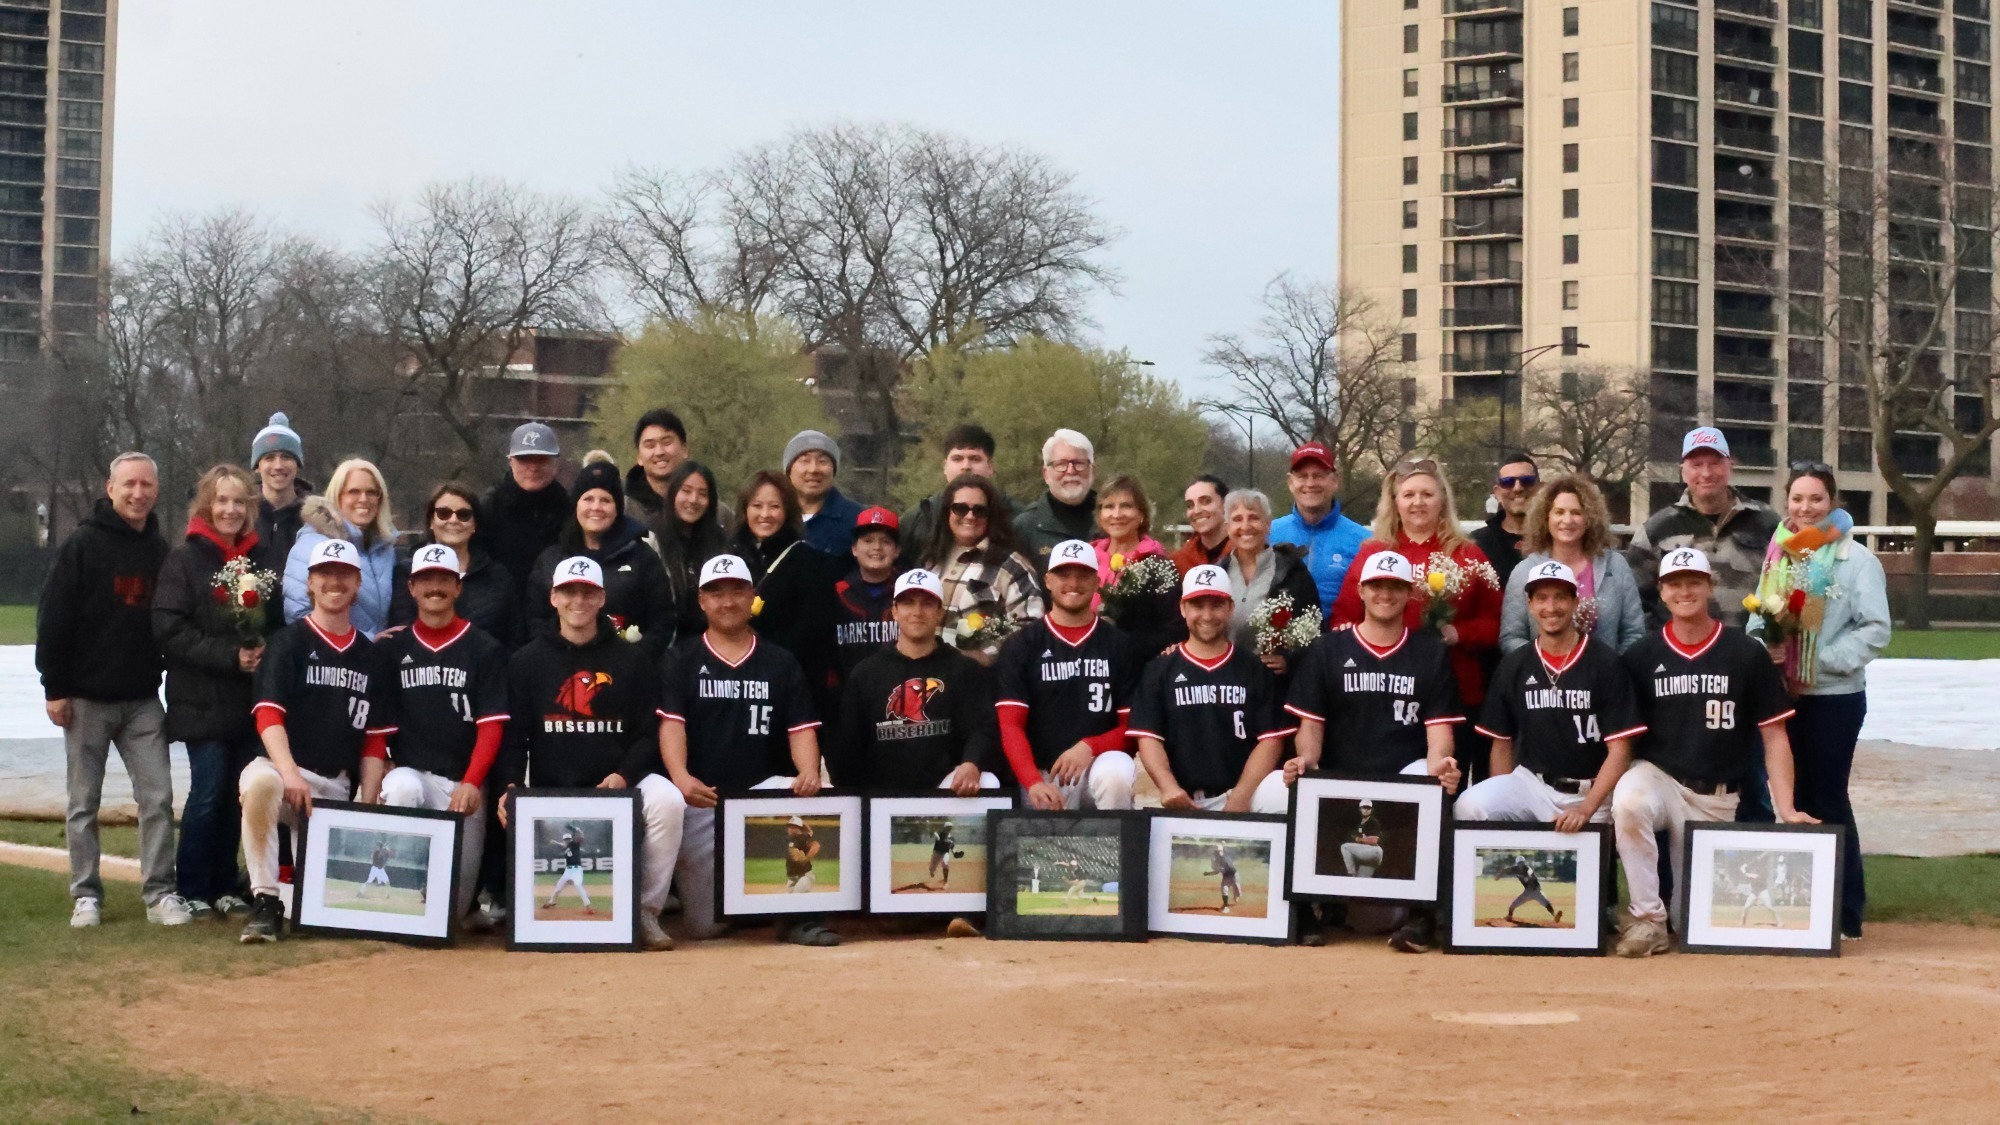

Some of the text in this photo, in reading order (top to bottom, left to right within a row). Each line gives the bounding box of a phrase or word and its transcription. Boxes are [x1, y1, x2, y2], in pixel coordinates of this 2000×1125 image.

[1692, 430, 1718, 446] Tech
[836, 620, 900, 645] BARNSTORM
[306, 665, 368, 694] ILLINOIS TECH
[400, 665, 467, 689] ILLINOIS TECH
[1041, 658, 1110, 681] ILLINOS TECH
[699, 678, 769, 700] ILLINOIS TECH
[1174, 684, 1247, 706] ILLINOIS TECH
[1343, 672, 1415, 695] ILLINOIS TECH
[1654, 674, 1729, 697] ILLINOIS TECH
[450, 692, 474, 722] 11
[1088, 682, 1113, 713] 37
[1565, 689, 1591, 710] TECH
[348, 695, 370, 730] 18
[748, 704, 774, 735] 15
[1705, 699, 1736, 730] 99
[543, 720, 624, 733] BASEBALL
[1233, 710, 1247, 740] 6
[1572, 714, 1602, 744] 14
